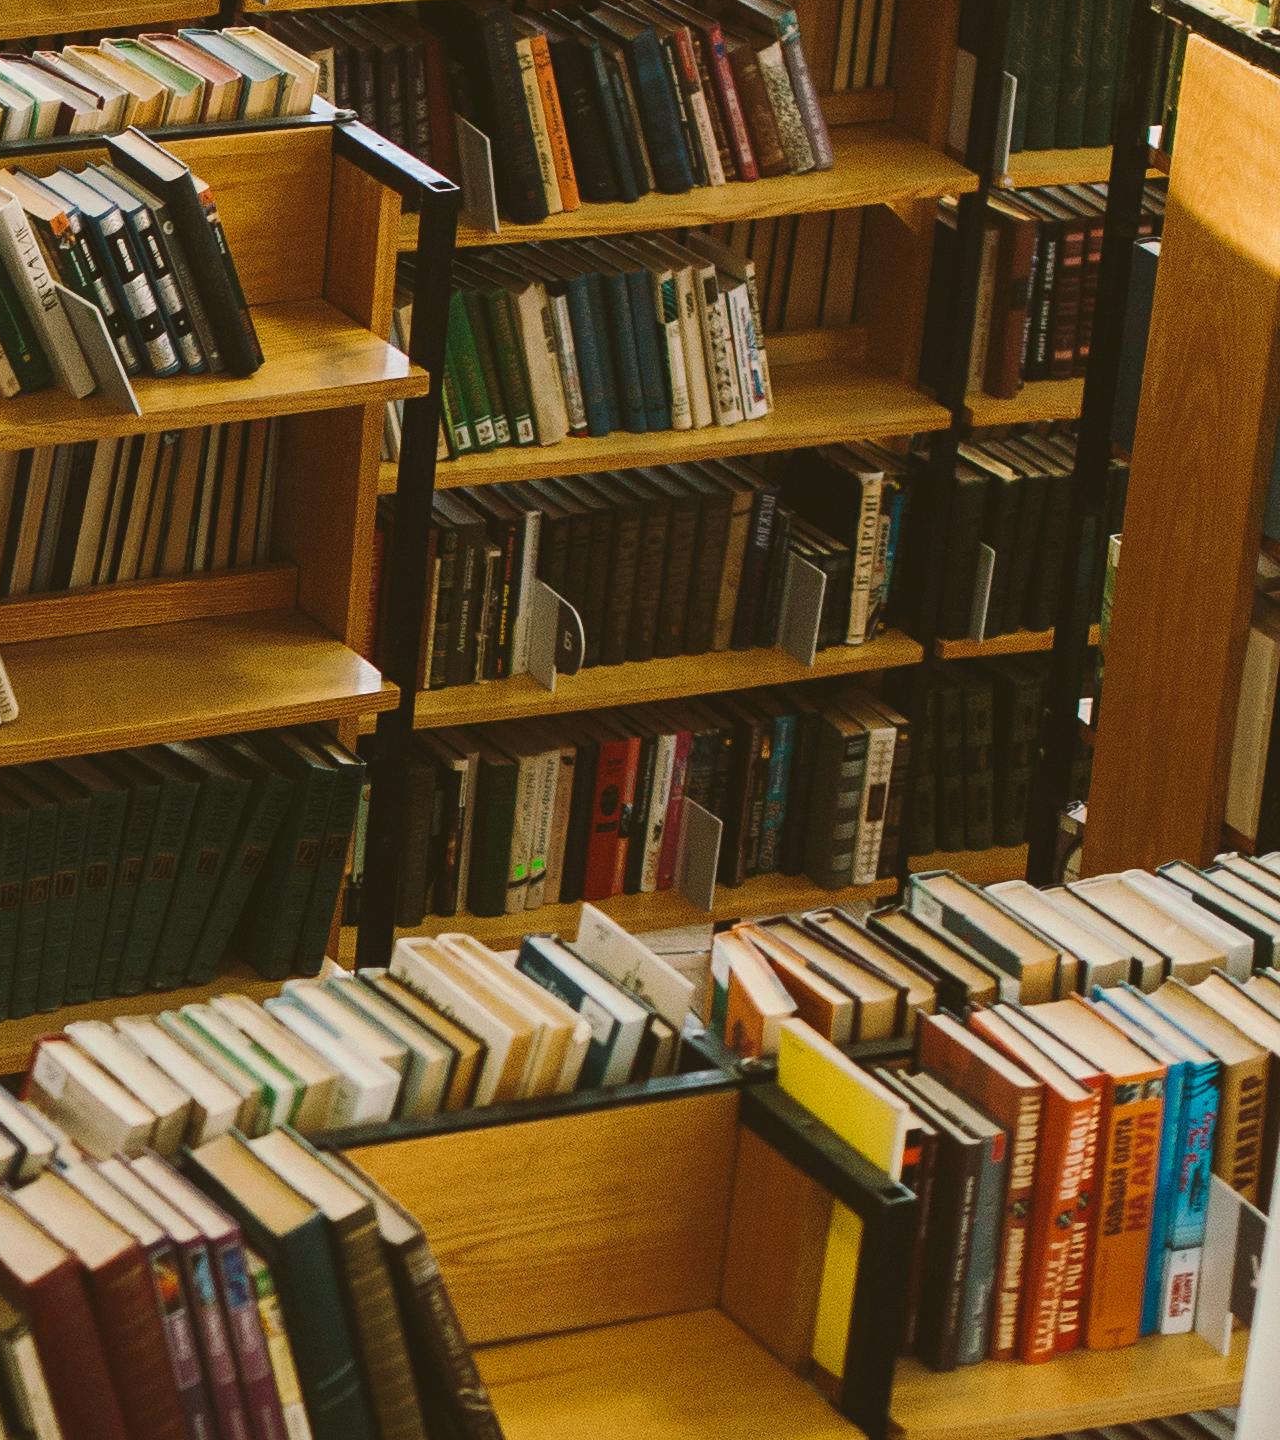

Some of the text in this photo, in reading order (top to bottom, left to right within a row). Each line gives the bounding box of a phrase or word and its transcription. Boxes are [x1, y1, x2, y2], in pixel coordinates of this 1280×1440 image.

[1058, 1109, 1089, 1200] ТОМПСОН
[1102, 1117, 1133, 1237] БОЛЬШАЯ ОХОТА
[1123, 1111, 1157, 1233] НА АКУЛ
[1064, 1220, 1089, 1292] АНГЕЛЫ
[1058, 1299, 1081, 1335] АДА
